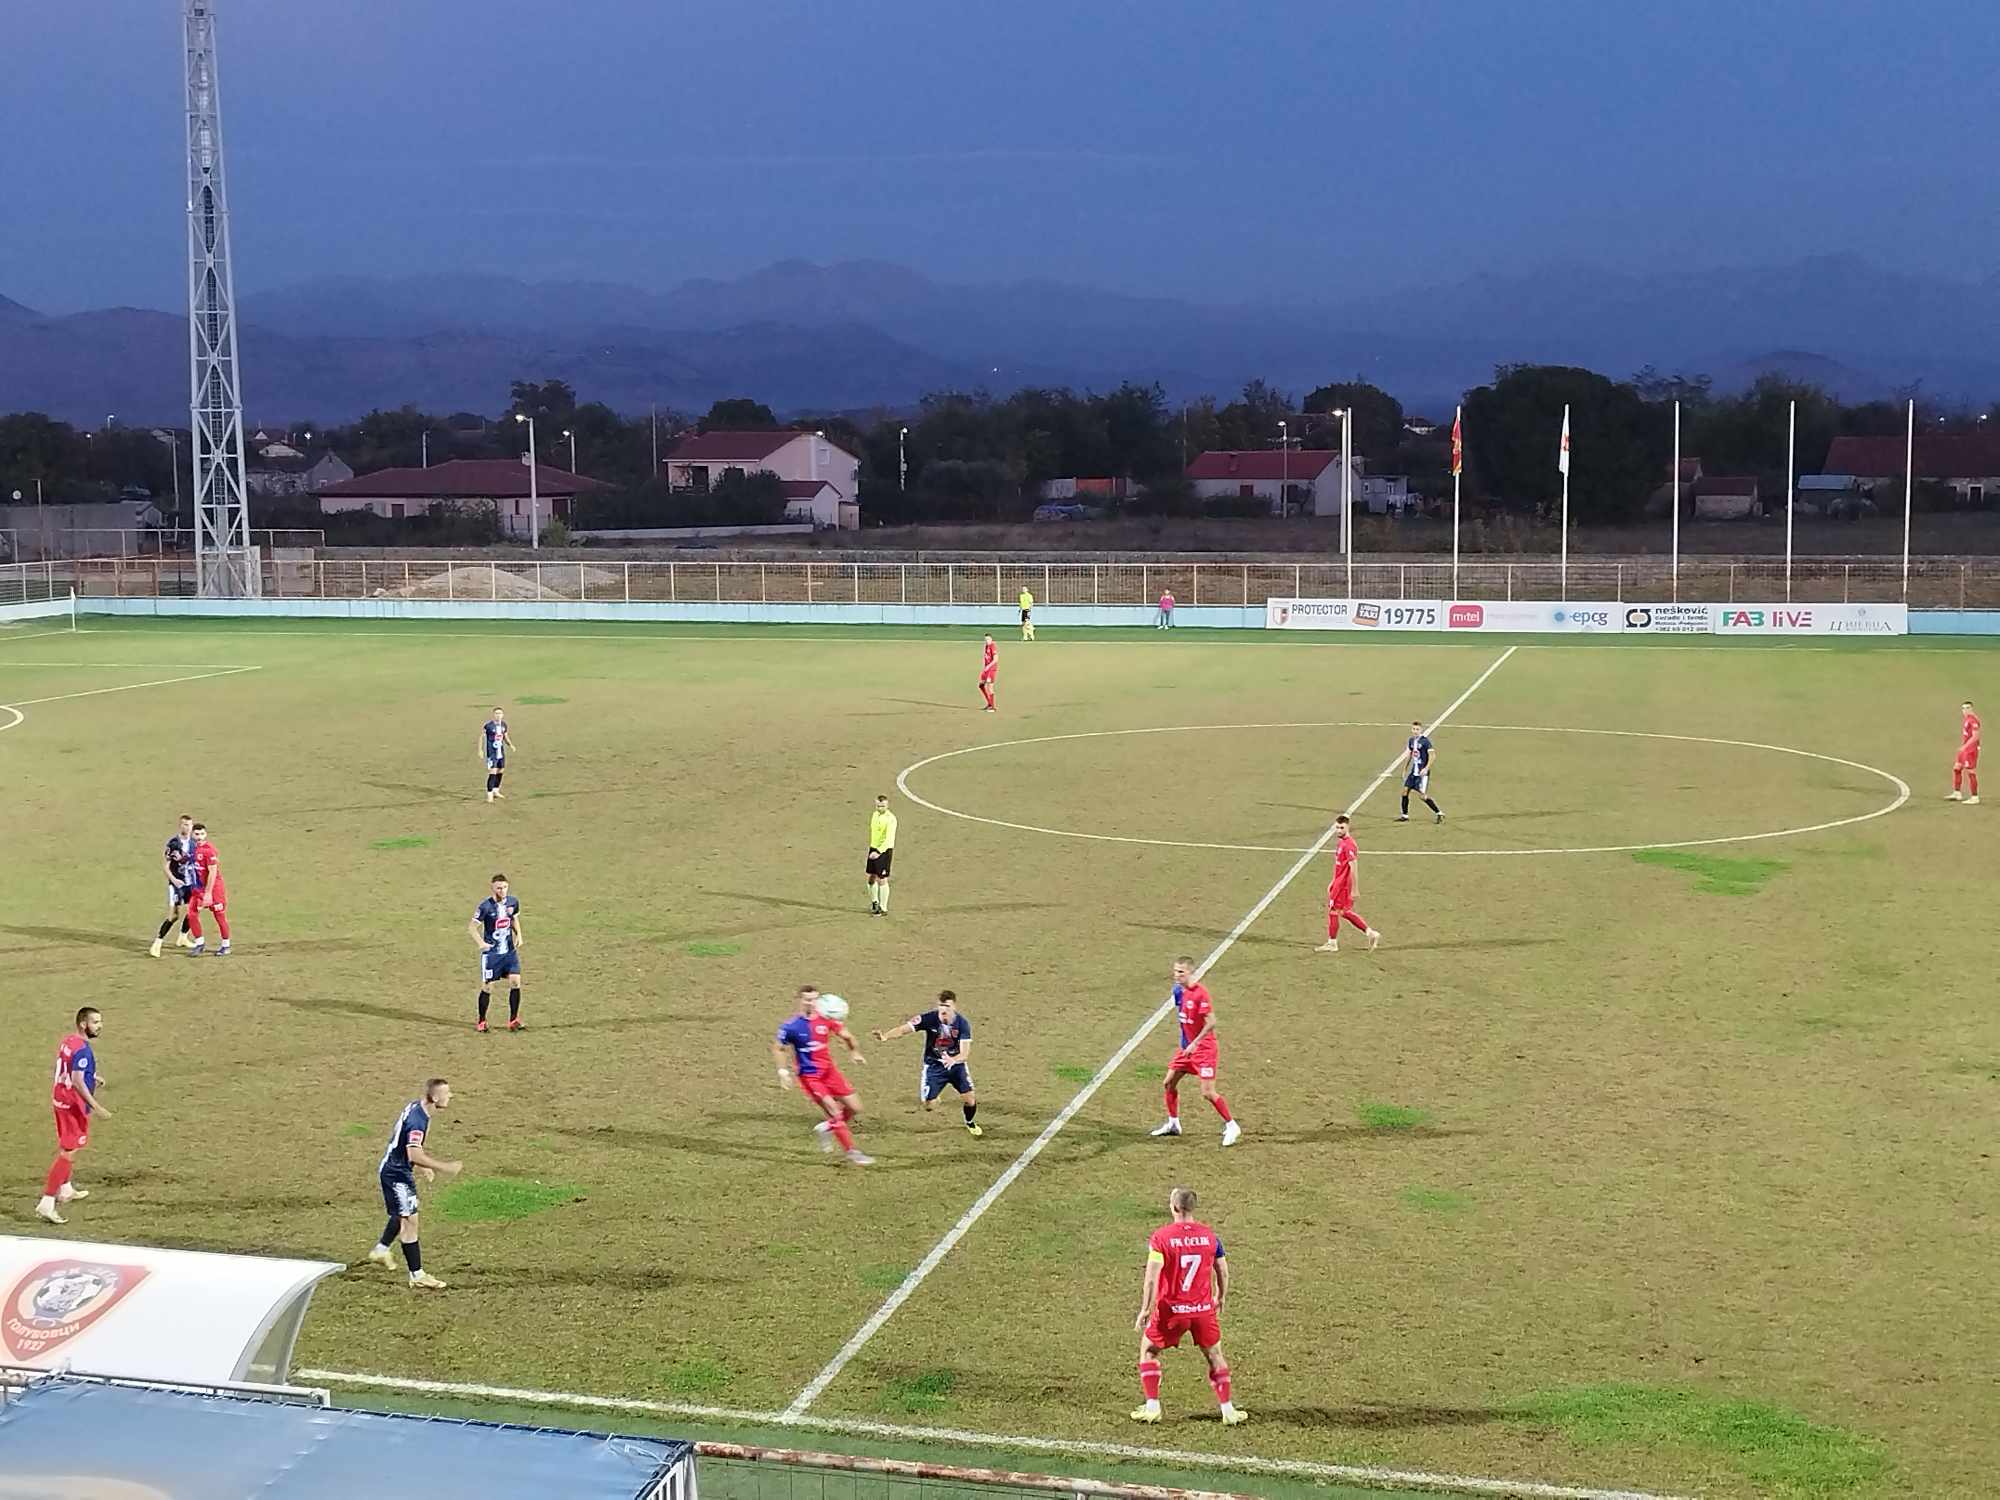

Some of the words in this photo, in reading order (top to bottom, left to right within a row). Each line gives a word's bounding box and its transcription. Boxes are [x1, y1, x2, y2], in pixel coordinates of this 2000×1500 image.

[1291, 603, 1348, 615] PROTECTOR
[1384, 608, 1436, 625] 19775
[1572, 609, 1609, 626] epcg
[1655, 605, 1709, 614] nešković
[1723, 610, 1765, 628] FAB
[1180, 1254, 1201, 1292] 7
[16, 1338, 47, 1351] 1927
